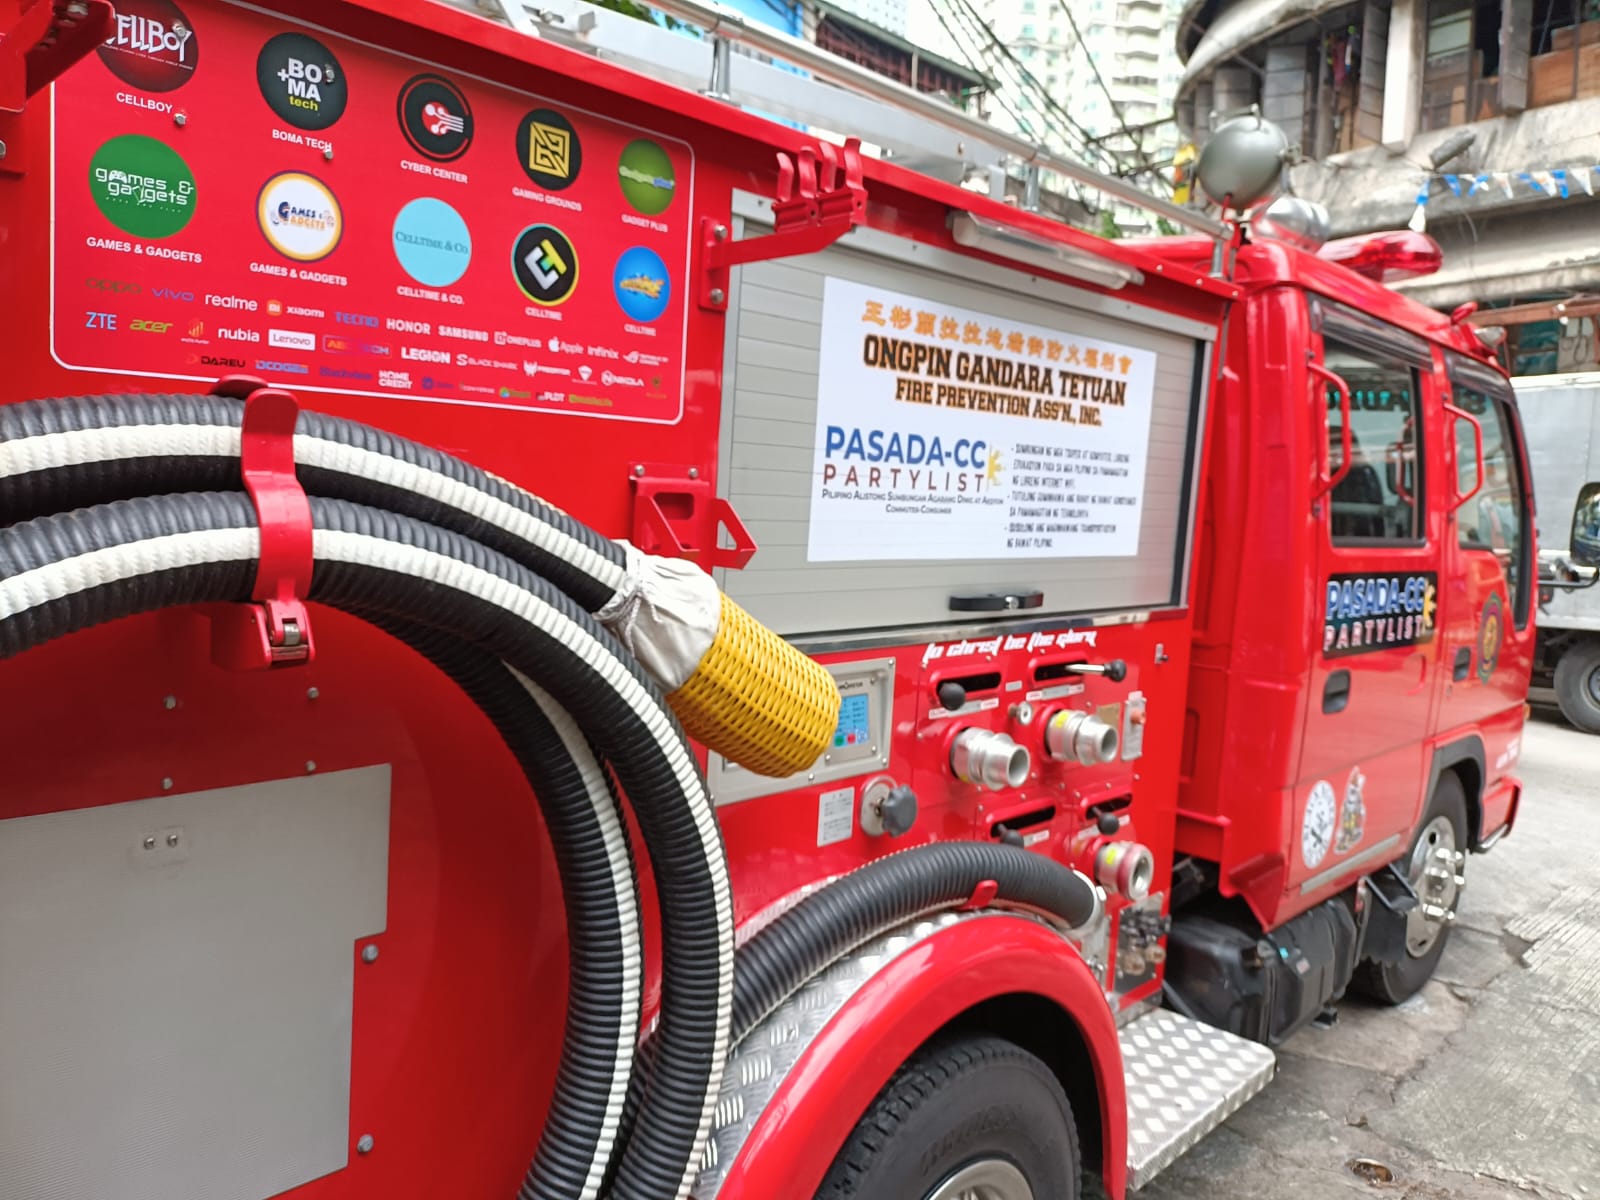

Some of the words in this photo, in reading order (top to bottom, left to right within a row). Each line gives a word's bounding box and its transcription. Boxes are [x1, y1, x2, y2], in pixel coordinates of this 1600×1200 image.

[104, 14, 193, 61] ELLBOY
[288, 58, 322, 83] BO
[116, 92, 173, 113] CELLBOY
[287, 79, 321, 102] MA
[289, 95, 318, 111] tech
[272, 129, 304, 146] BOMA
[305, 137, 332, 151] TECH
[400, 159, 432, 176] CYBER
[433, 166, 468, 184] CENTER
[86, 236, 131, 252] GAMES
[134, 244, 143, 254] &
[145, 245, 202, 263] GADGETS
[250, 262, 287, 277] GAMES
[289, 268, 298, 278] &
[299, 270, 347, 286] GADGETS
[397, 285, 440, 301] CELLTIME
[205, 293, 258, 311] realme
[286, 305, 325, 318] xiaomi
[387, 317, 431, 335] HONOR
[438, 324, 489, 343] SAMSUNG
[85, 311, 118, 331] ZTE
[130, 319, 173, 333] acer
[218, 327, 260, 342] nubia
[273, 333, 311, 346] Lenovo
[401, 347, 451, 365] LEGION
[200, 355, 246, 368] DAREU
[864, 333, 951, 378] ONGPIN
[956, 352, 1054, 396] GANDARA
[1059, 370, 1127, 406] TETUAN
[895, 377, 933, 402] FIRE
[936, 384, 1031, 416] PREVENTION
[1079, 405, 1102, 426] INC.
[825, 425, 986, 469] PASADA-CC
[823, 464, 984, 493] PARTYLIST
[1326, 577, 1426, 620] PASADA-CC
[1323, 615, 1423, 652] PARTYLIST
